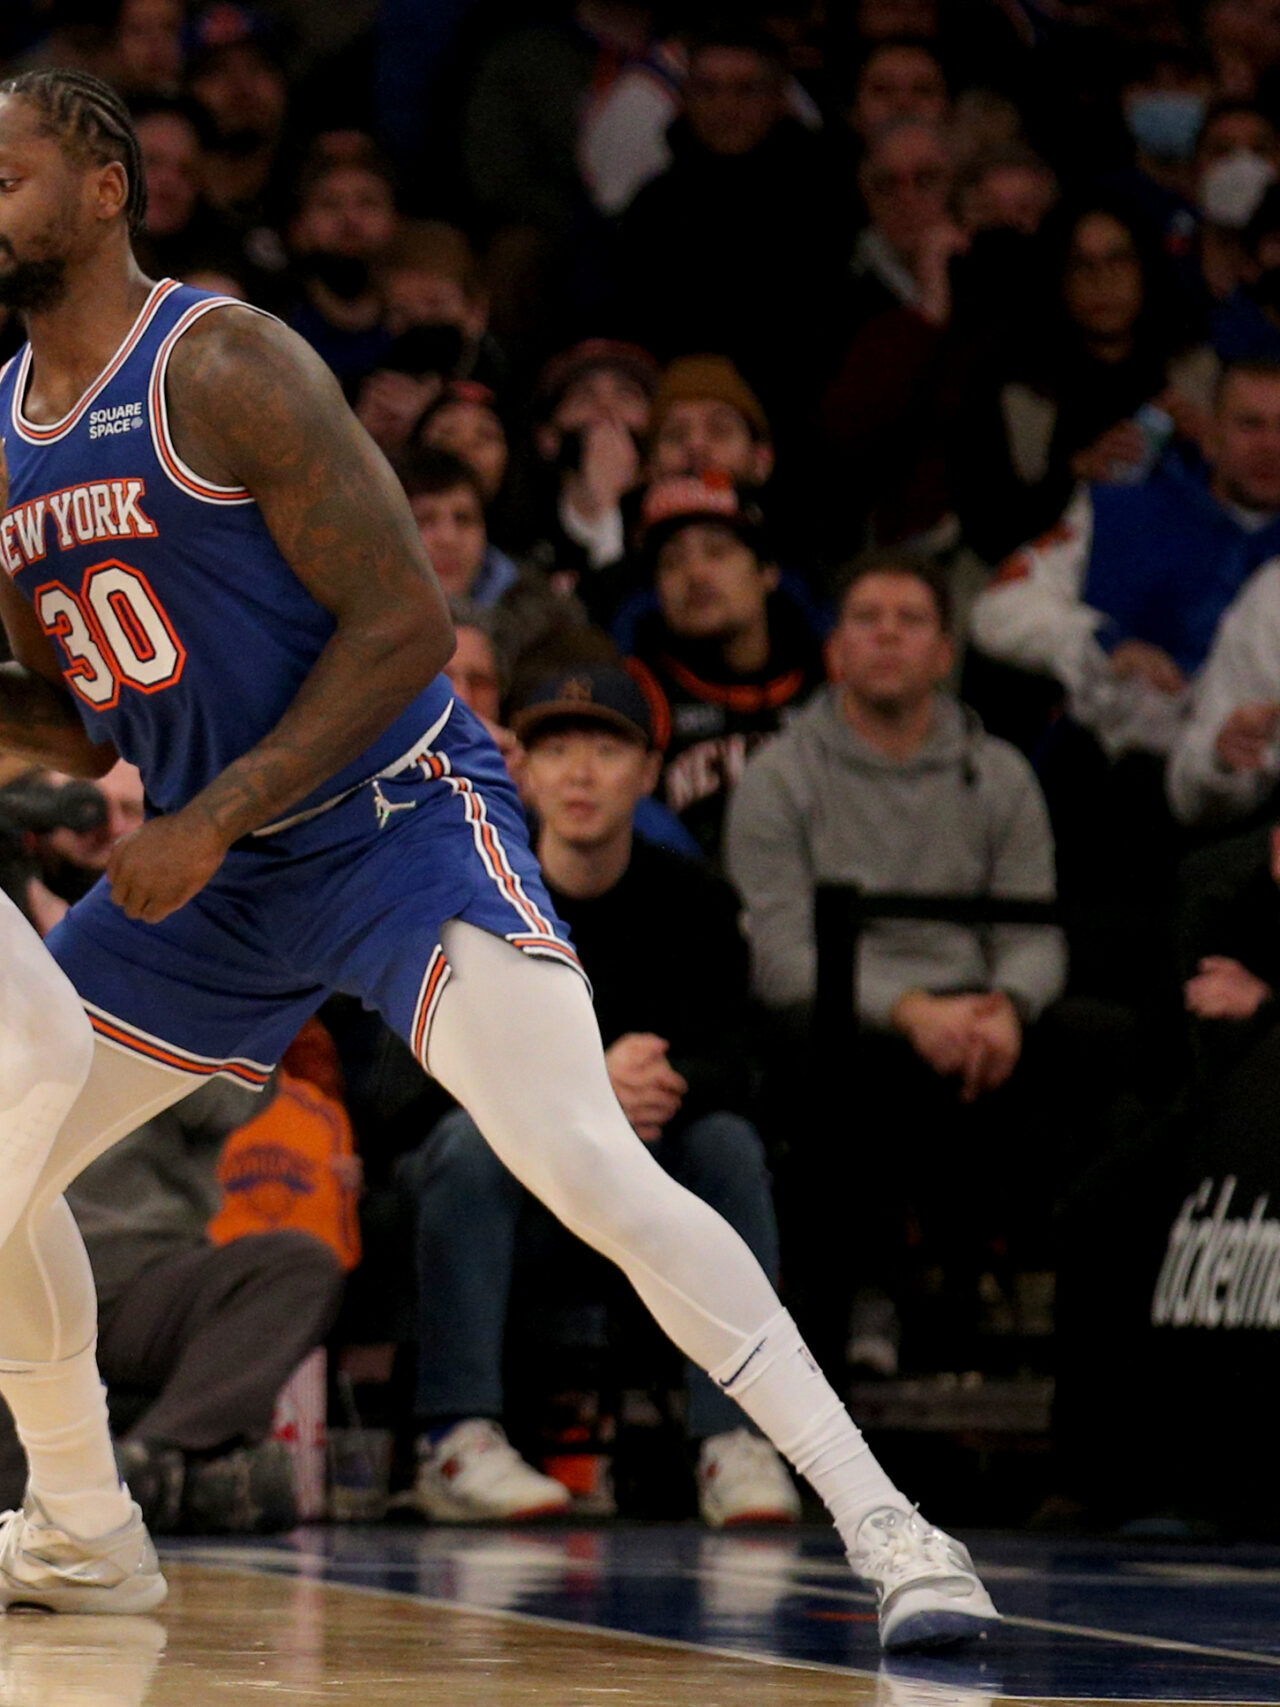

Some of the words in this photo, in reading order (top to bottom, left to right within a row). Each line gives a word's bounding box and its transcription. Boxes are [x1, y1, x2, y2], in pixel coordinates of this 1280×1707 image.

[89, 402, 142, 425] SQUARE
[89, 418, 131, 439] SPACE
[48, 478, 158, 549] YORK
[34, 558, 187, 711] 30
